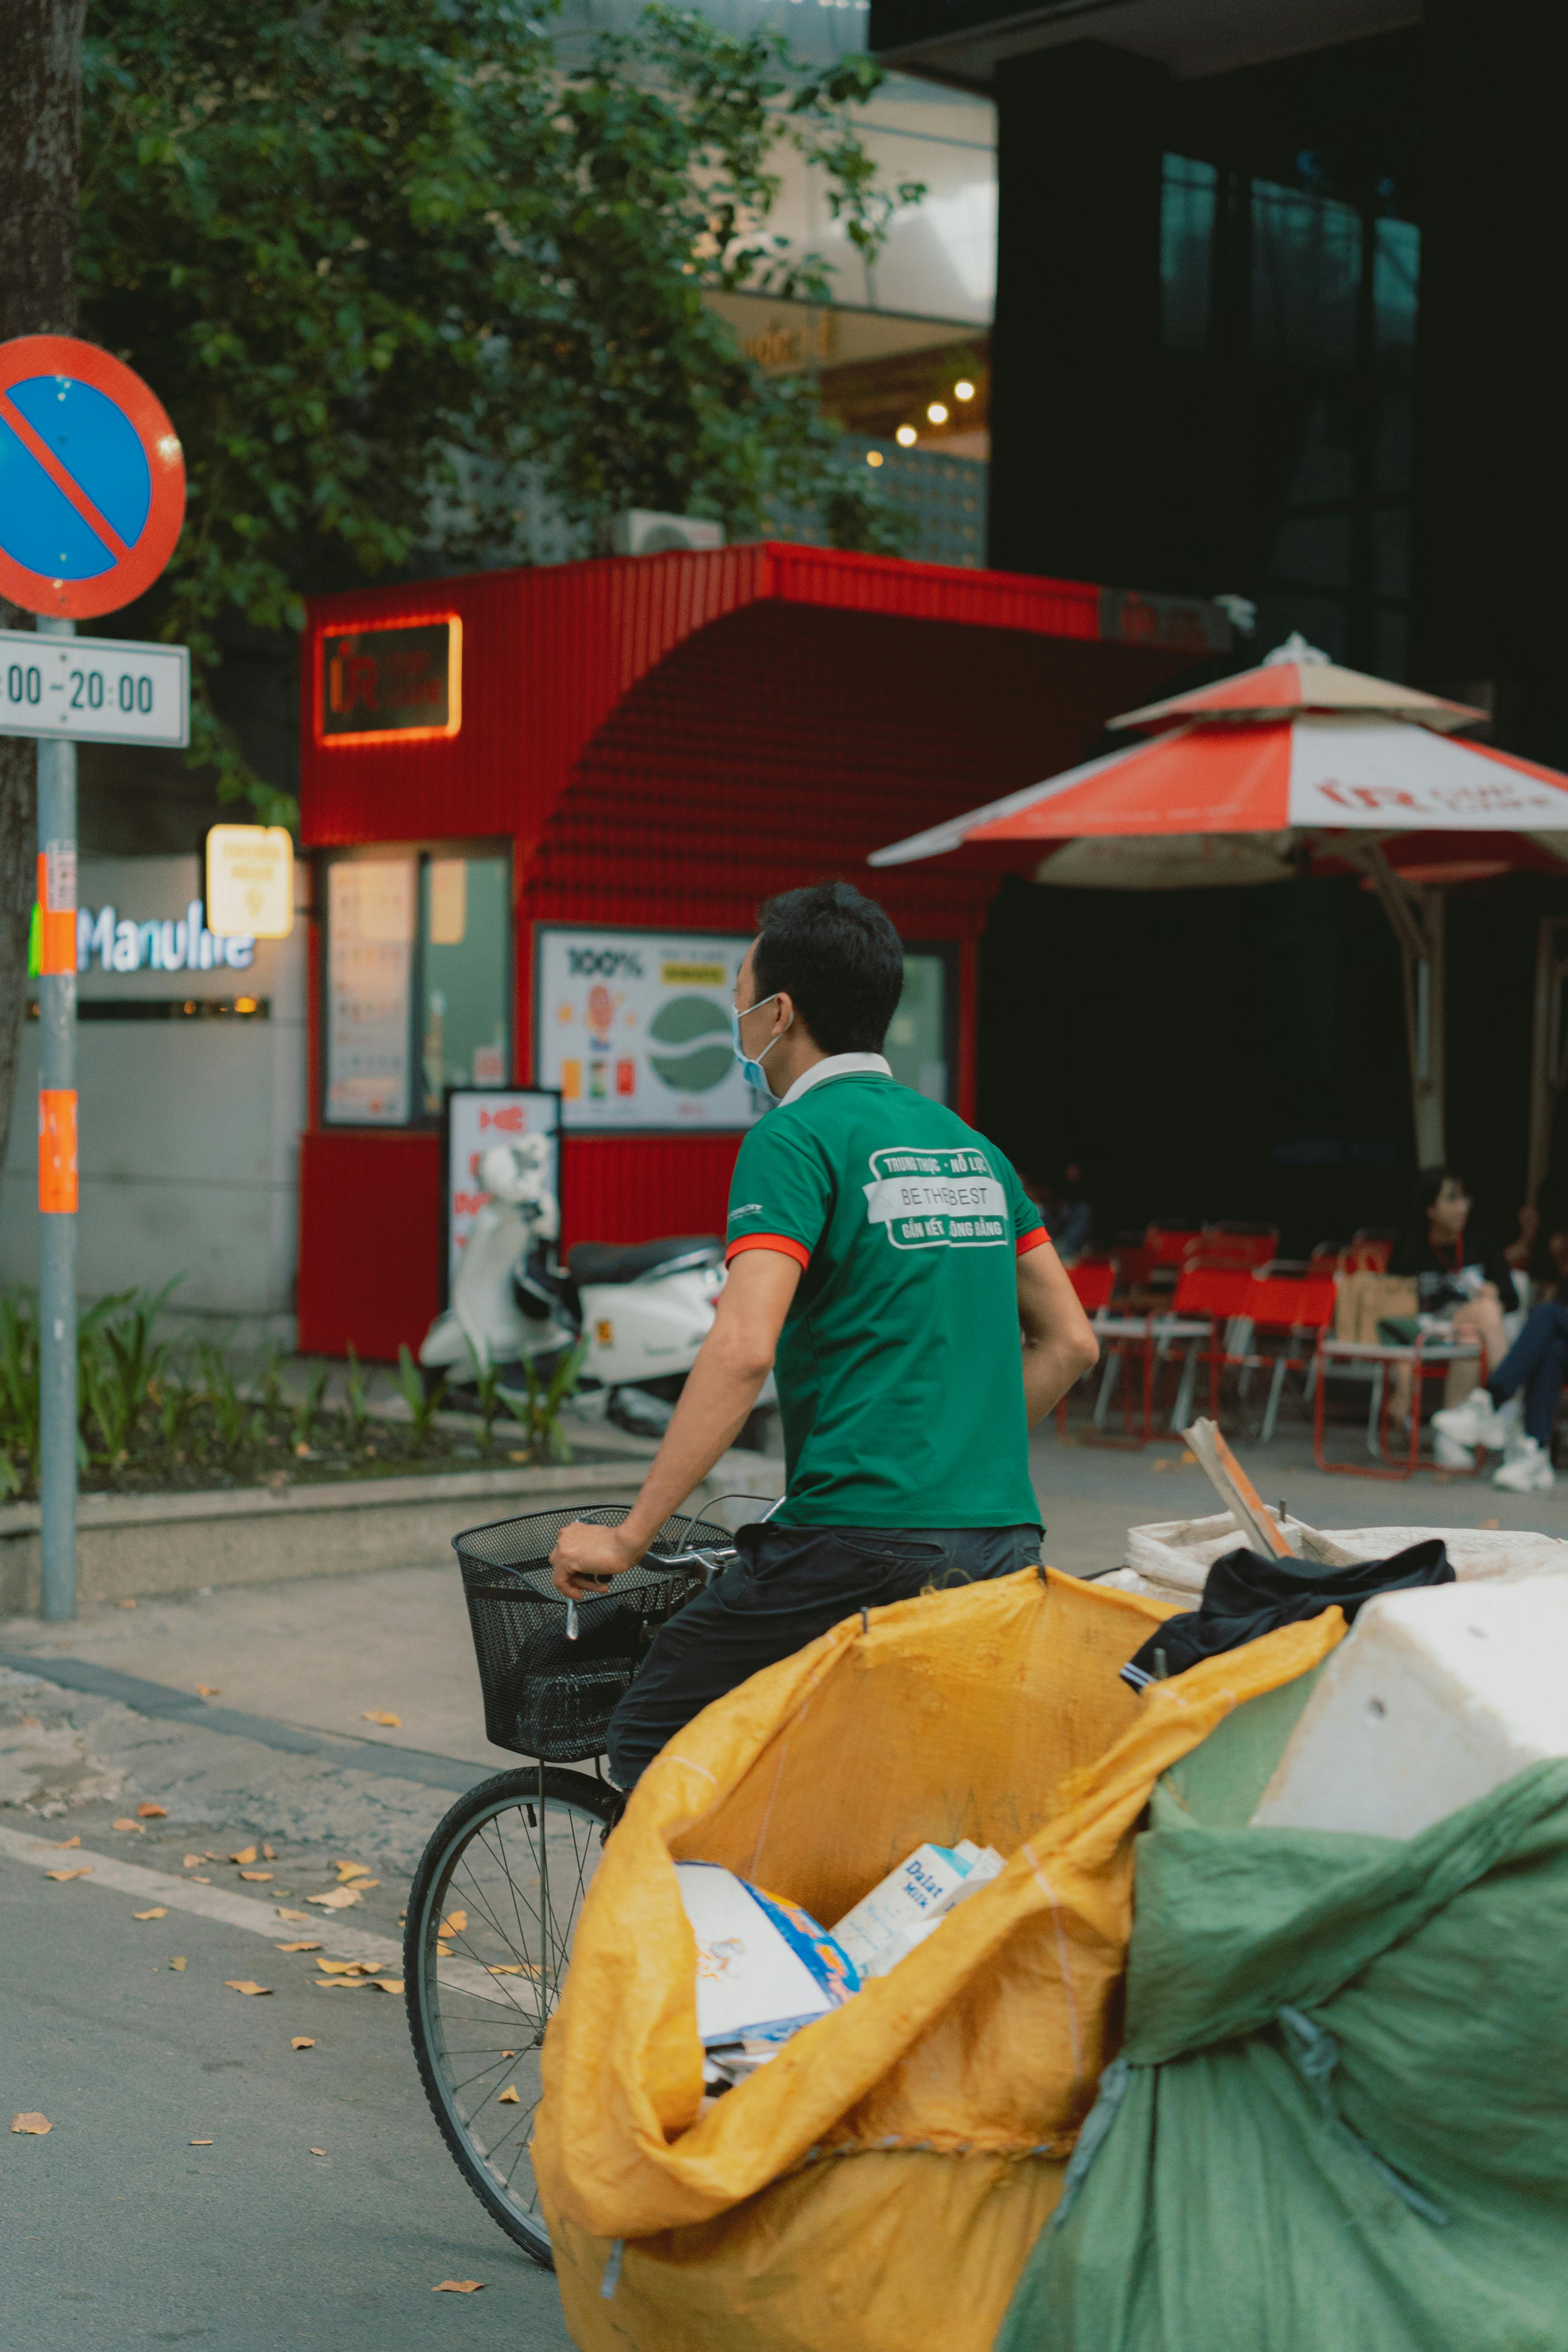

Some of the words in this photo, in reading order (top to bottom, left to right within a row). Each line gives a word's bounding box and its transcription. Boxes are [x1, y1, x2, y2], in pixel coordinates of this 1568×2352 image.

[567, 947, 643, 979] 100%
[883, 1157, 918, 1172] TRUNG
[901, 1188, 922, 1205] BE
[922, 1188, 949, 1204] THE
[949, 1188, 987, 1205] BEST
[949, 1220, 974, 1237] ÔNG
[906, 1860, 943, 1899] Dalat
[904, 1882, 929, 1908] Milk
